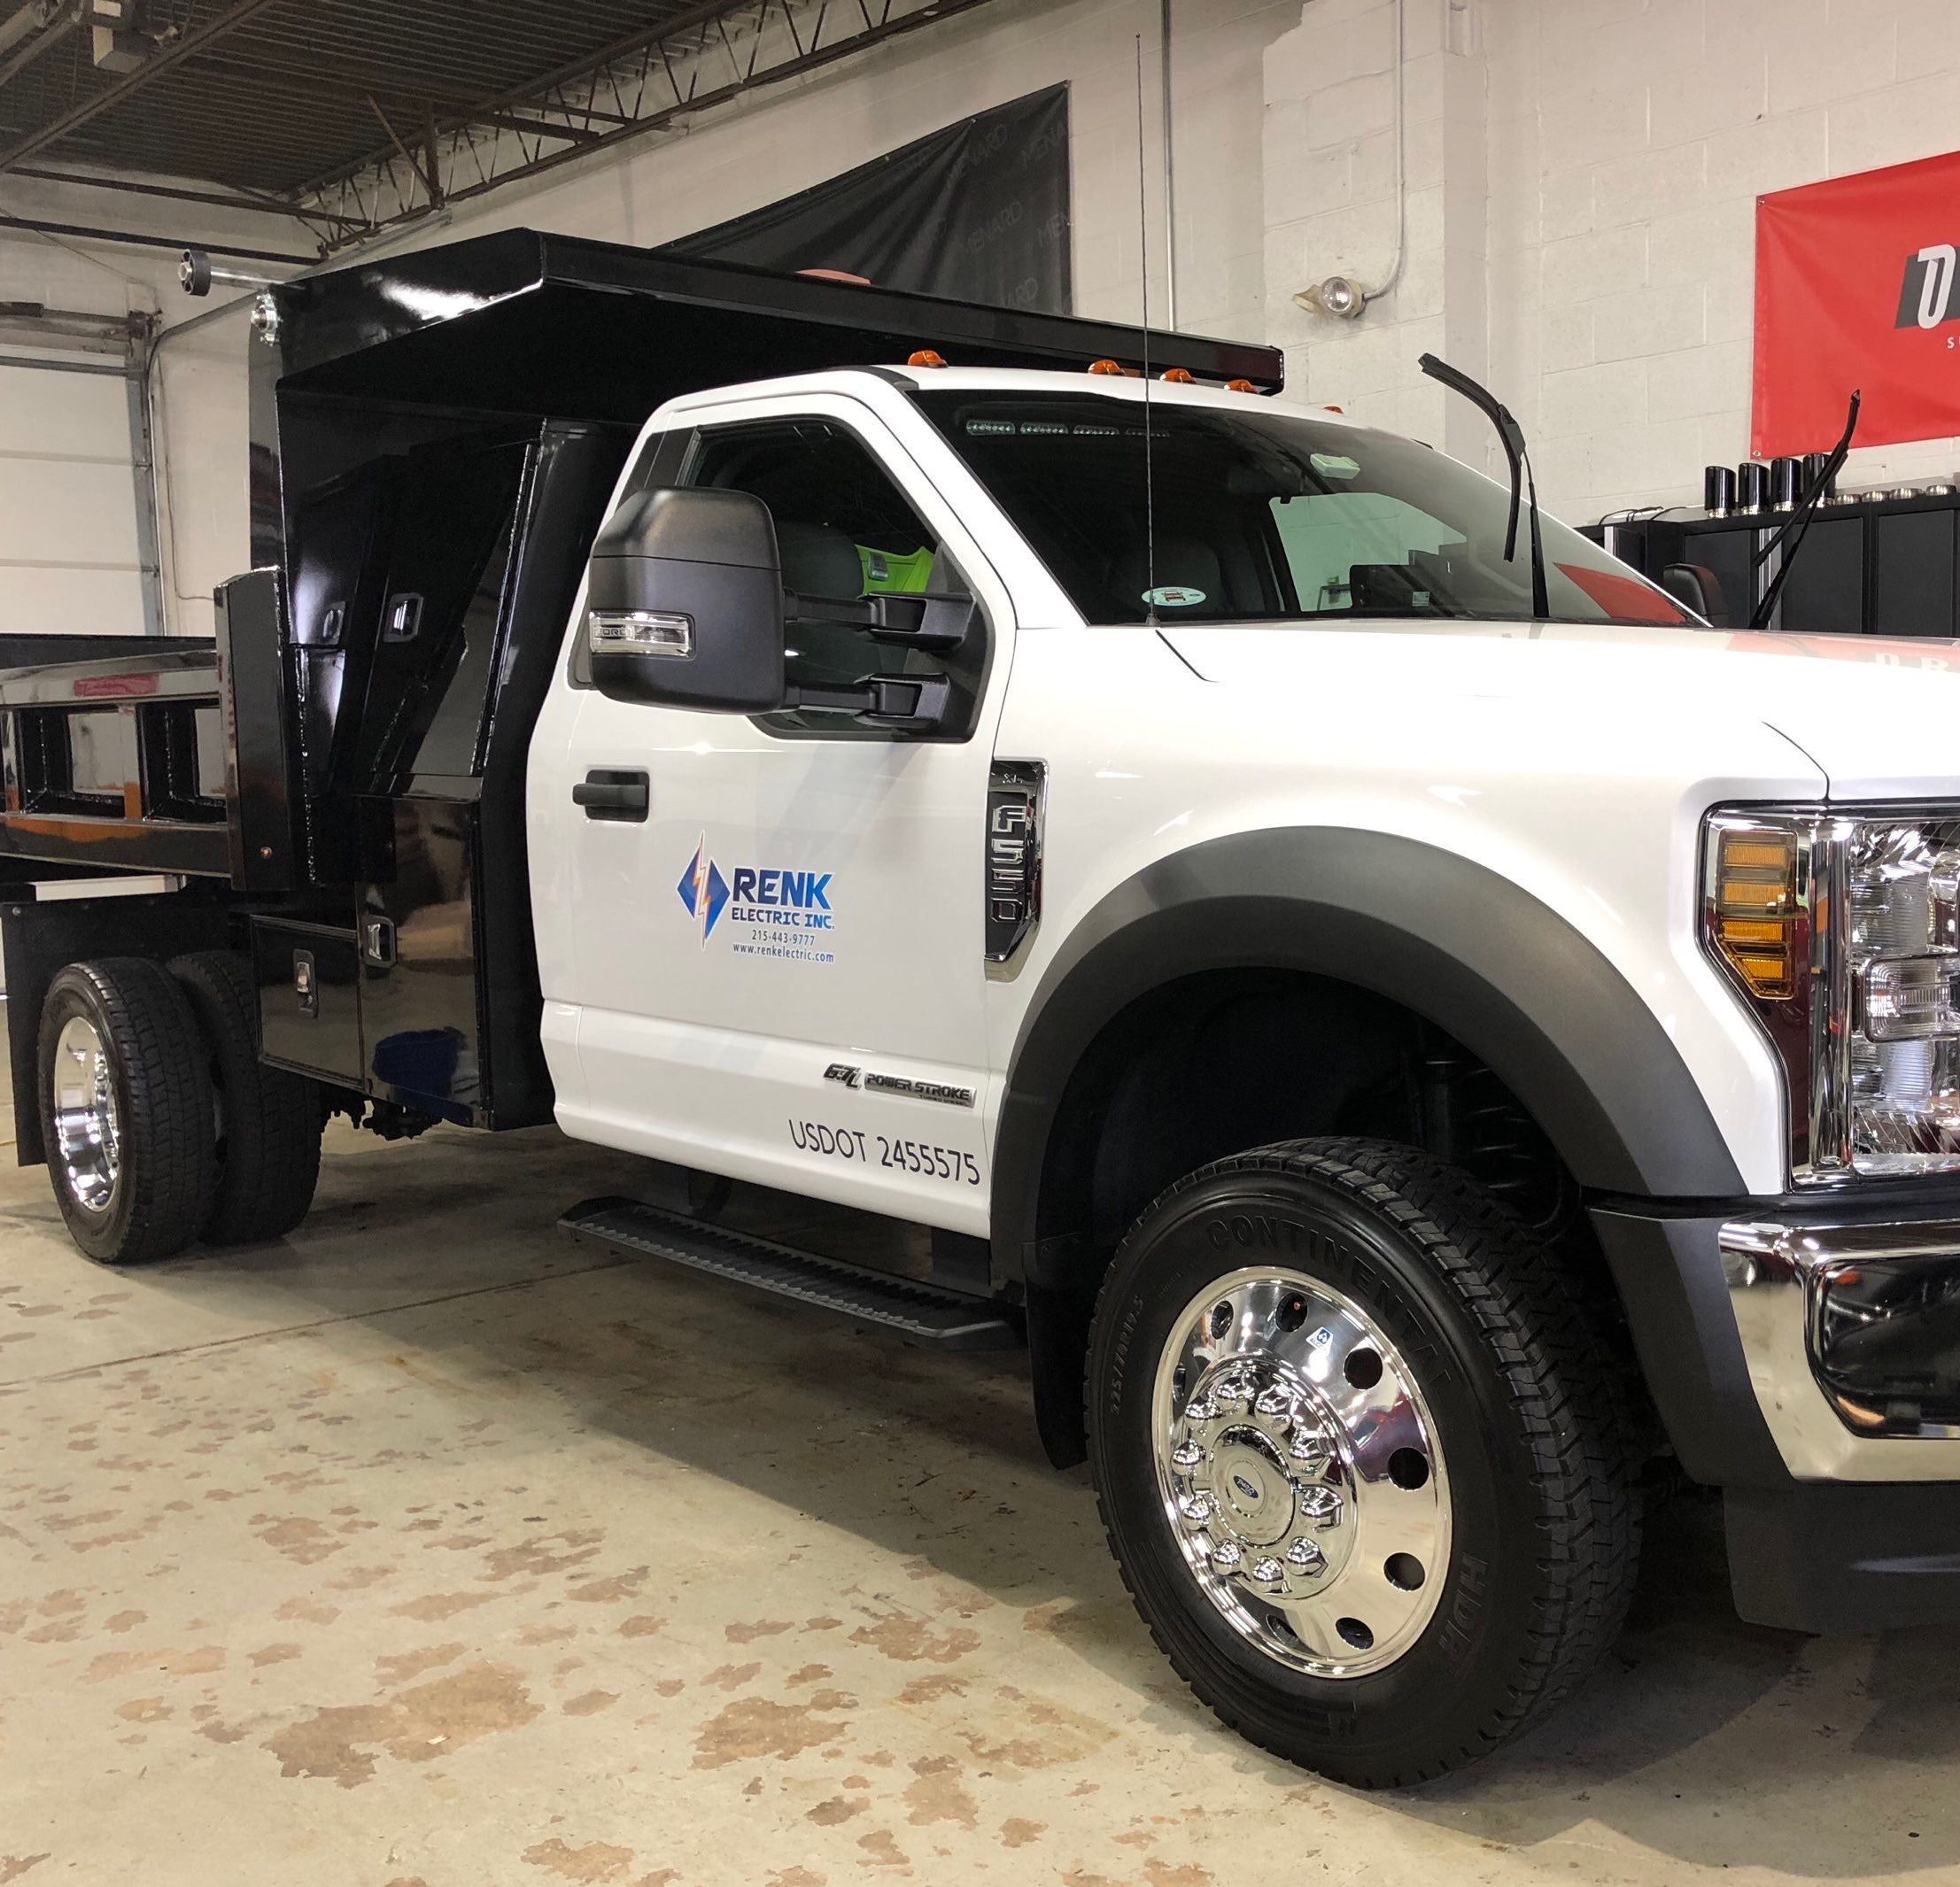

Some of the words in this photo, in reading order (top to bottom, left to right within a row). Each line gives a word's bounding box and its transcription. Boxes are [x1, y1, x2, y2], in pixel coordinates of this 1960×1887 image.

[1947, 336, 1960, 350] S
[732, 867, 833, 910] RENK
[732, 908, 801, 927] ELECTRIC
[804, 913, 835, 930] INC.
[752, 929, 815, 946] 215-443-9777
[733, 943, 834, 963] www.renkelectric.com
[866, 1072, 912, 1091] POWER
[914, 1081, 971, 1101] STROKE
[788, 1118, 866, 1163] USDOT
[876, 1135, 980, 1186] 2455575
